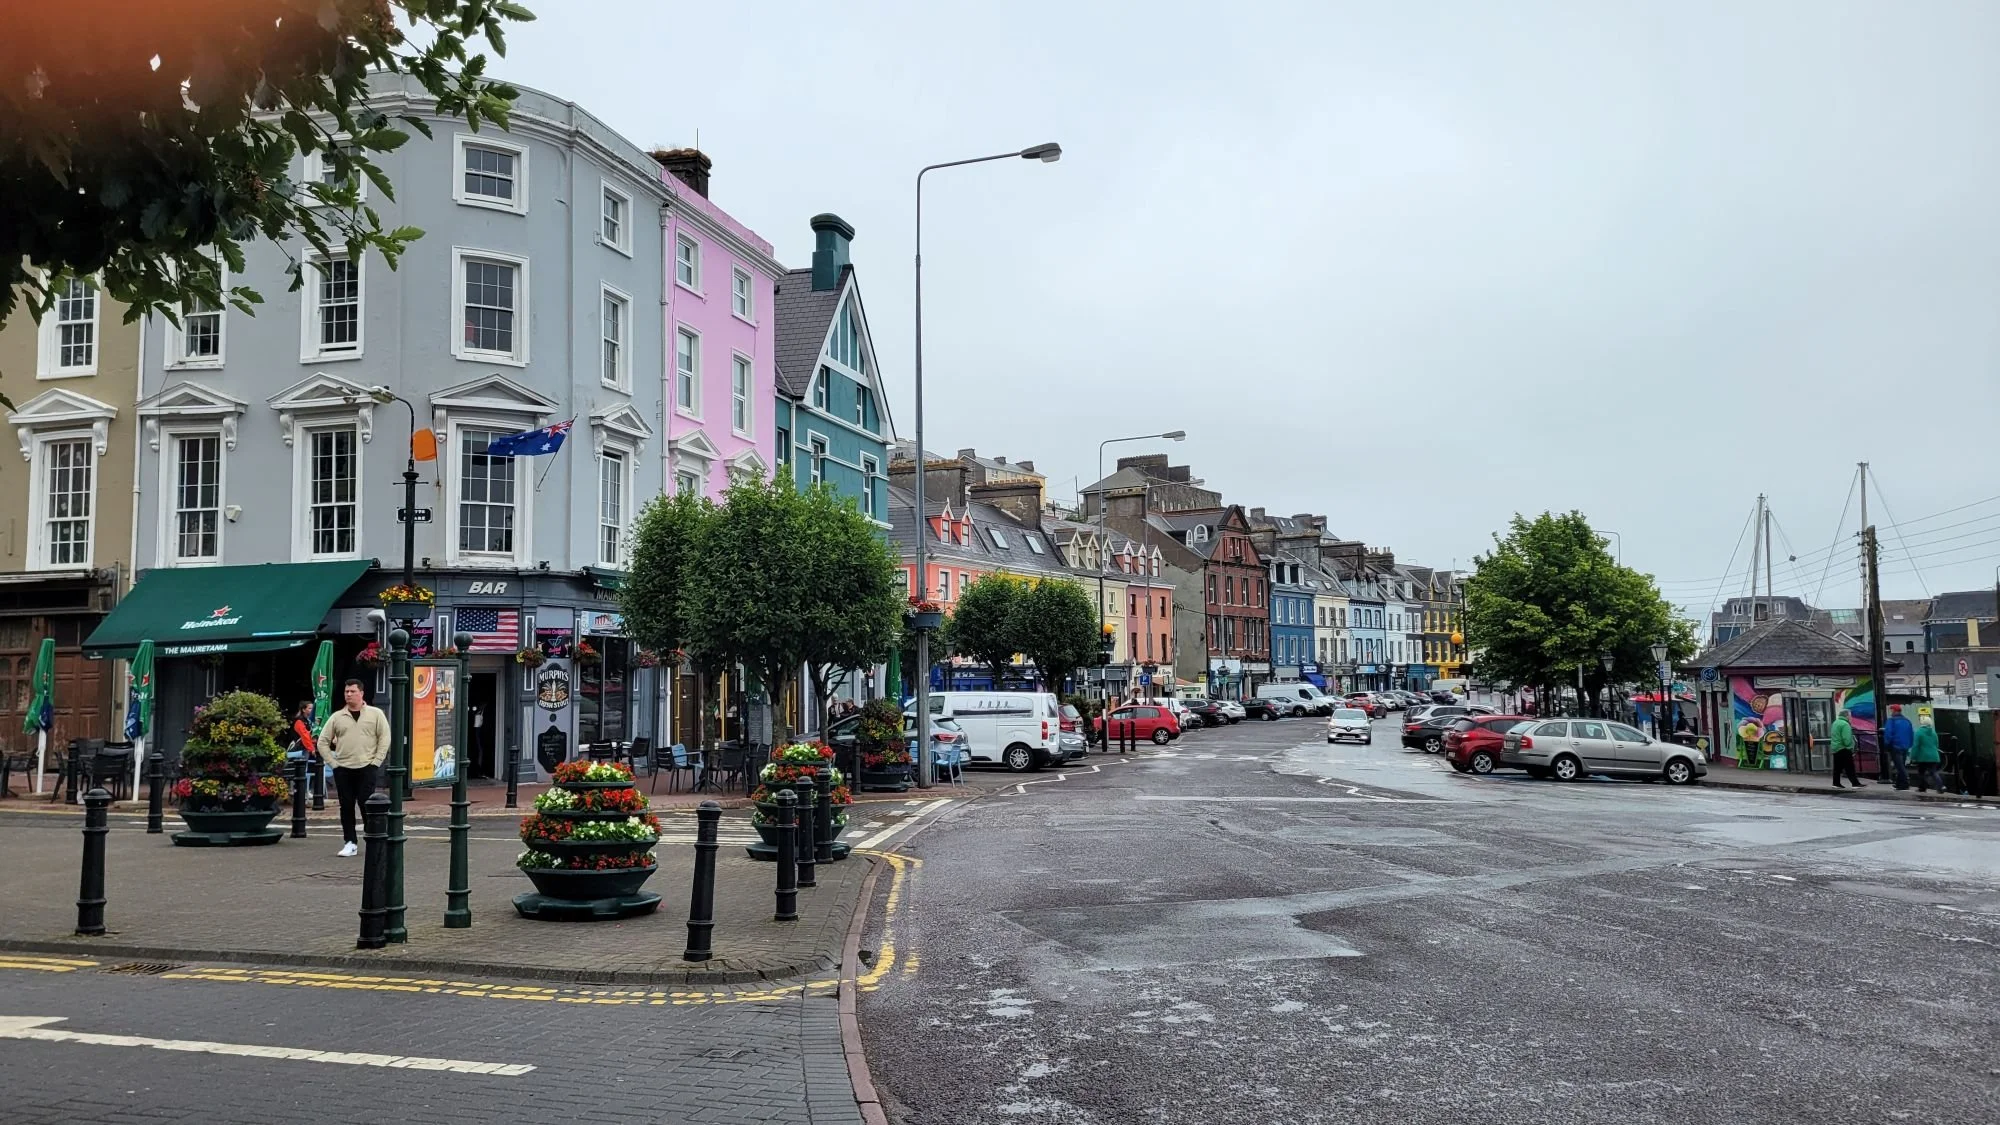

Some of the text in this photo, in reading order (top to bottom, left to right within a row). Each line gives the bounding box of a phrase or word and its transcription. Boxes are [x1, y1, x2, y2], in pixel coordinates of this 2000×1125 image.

[468, 582, 507, 594] BAR
[180, 617, 241, 629] Heineken
[180, 644, 228, 654] MAURETANIA
